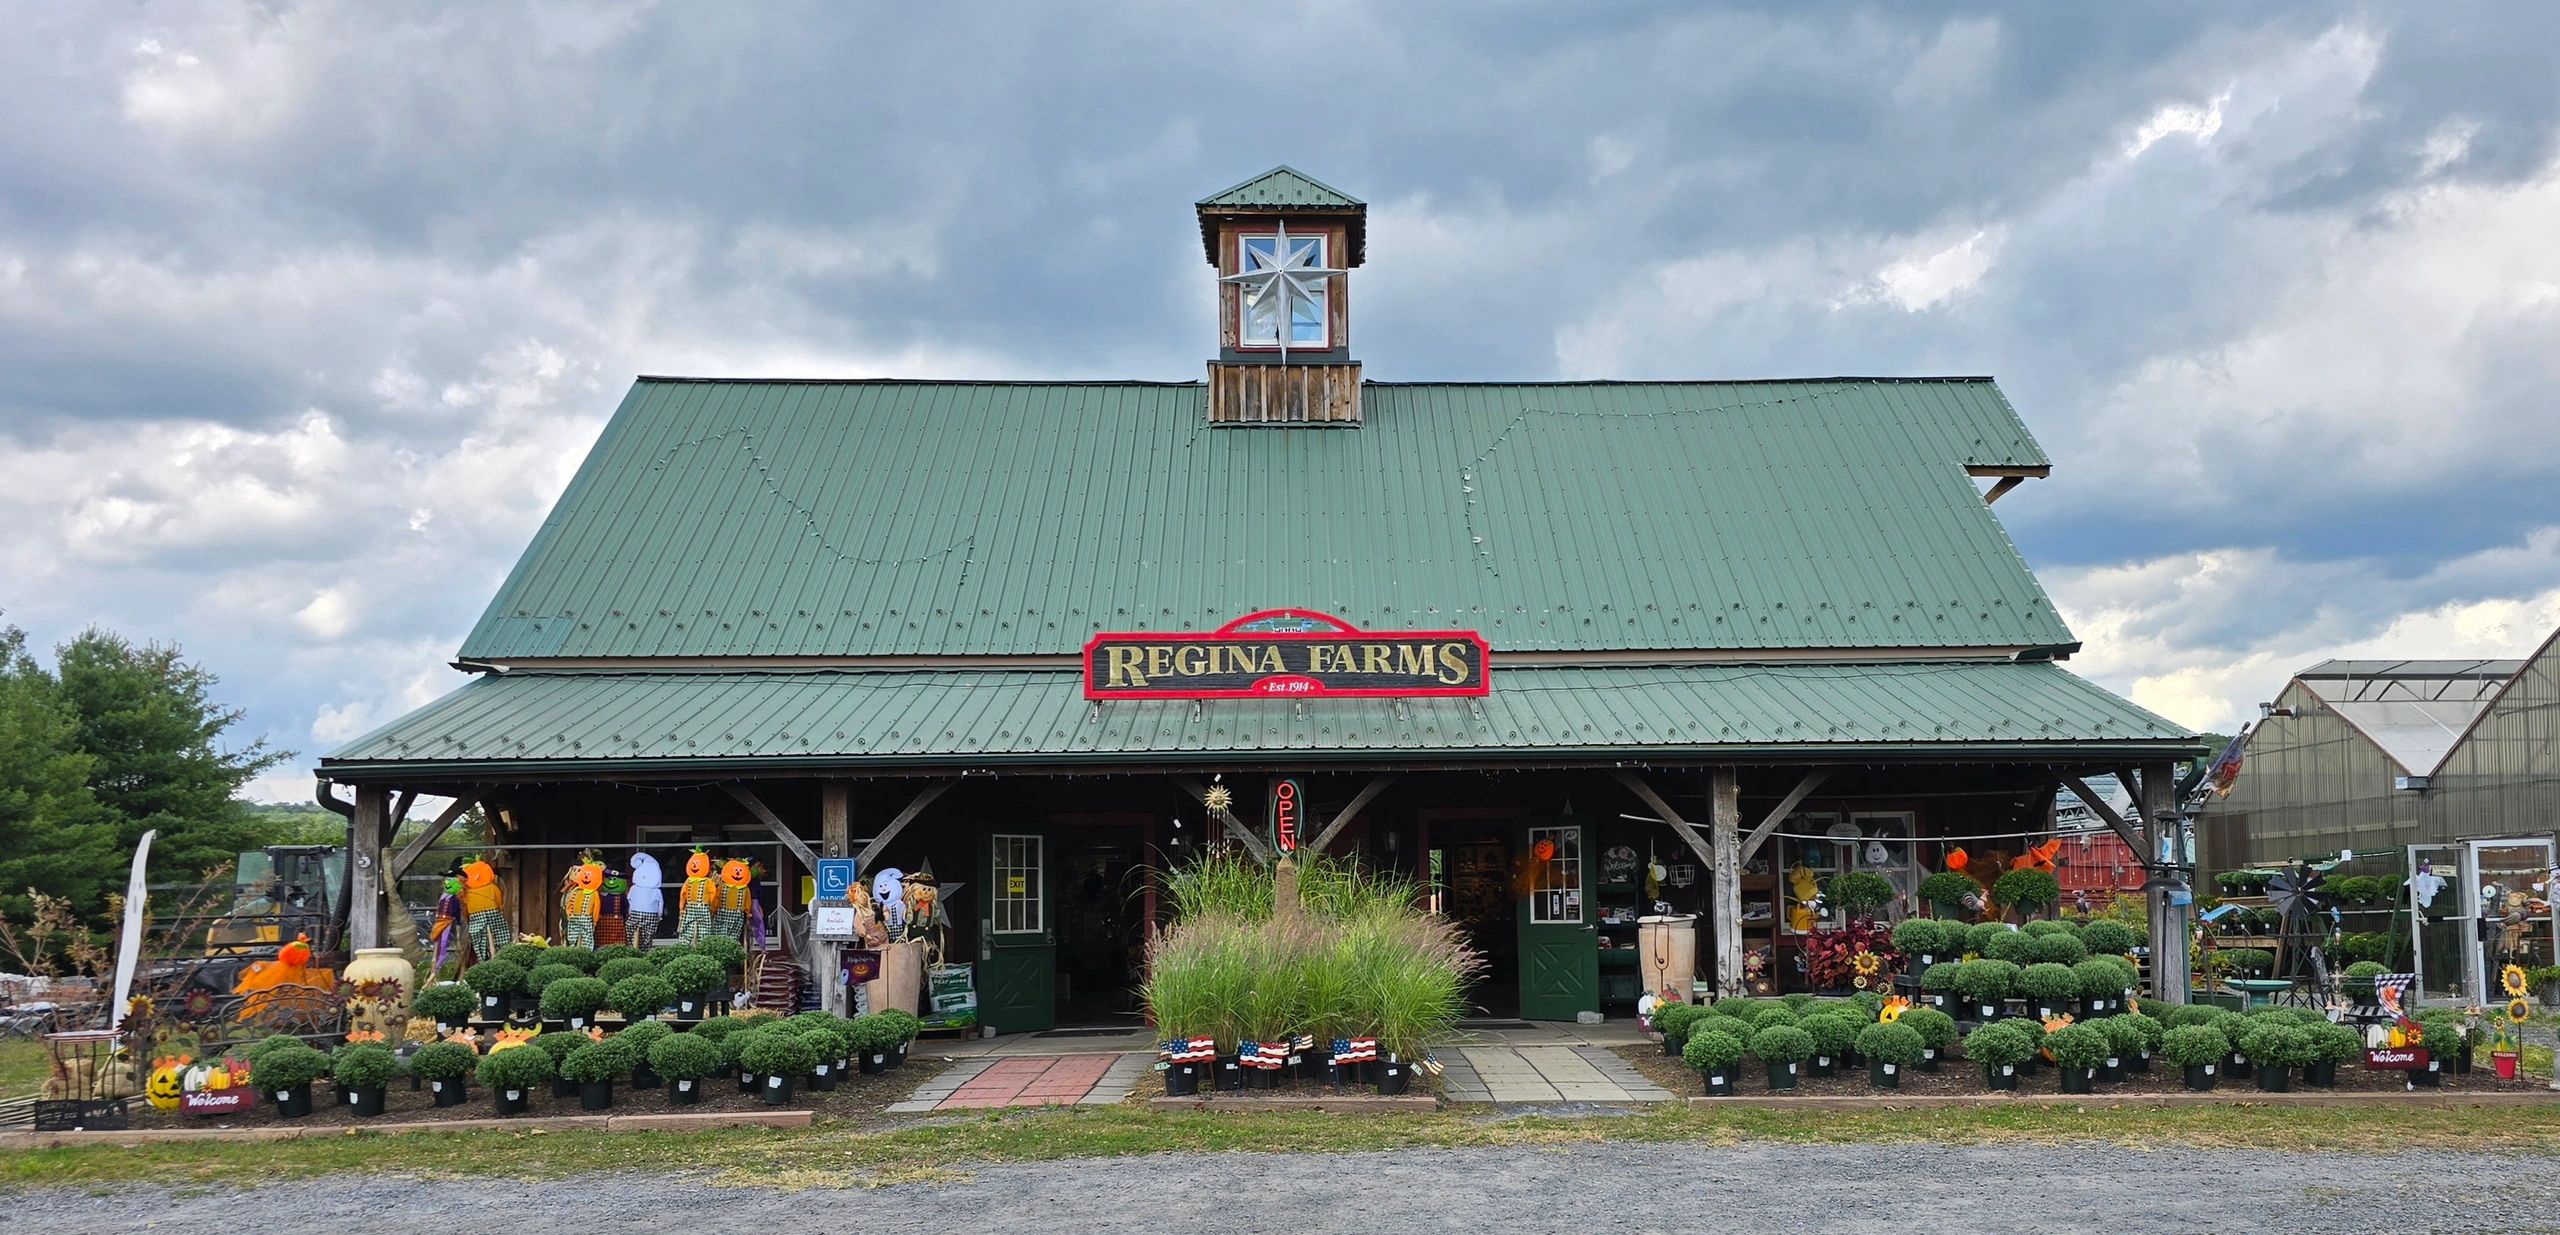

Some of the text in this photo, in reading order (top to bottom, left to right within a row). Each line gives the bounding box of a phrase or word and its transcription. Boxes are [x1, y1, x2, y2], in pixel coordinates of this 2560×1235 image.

[1104, 642, 1469, 688] REGINA FARMS
[1288, 681, 1310, 693] 1914
[1277, 783, 1295, 850] OPEN
[1010, 880, 1024, 889] EXIT
[2370, 1050, 2415, 1063] Welcome
[185, 1094, 240, 1107] Welcome
